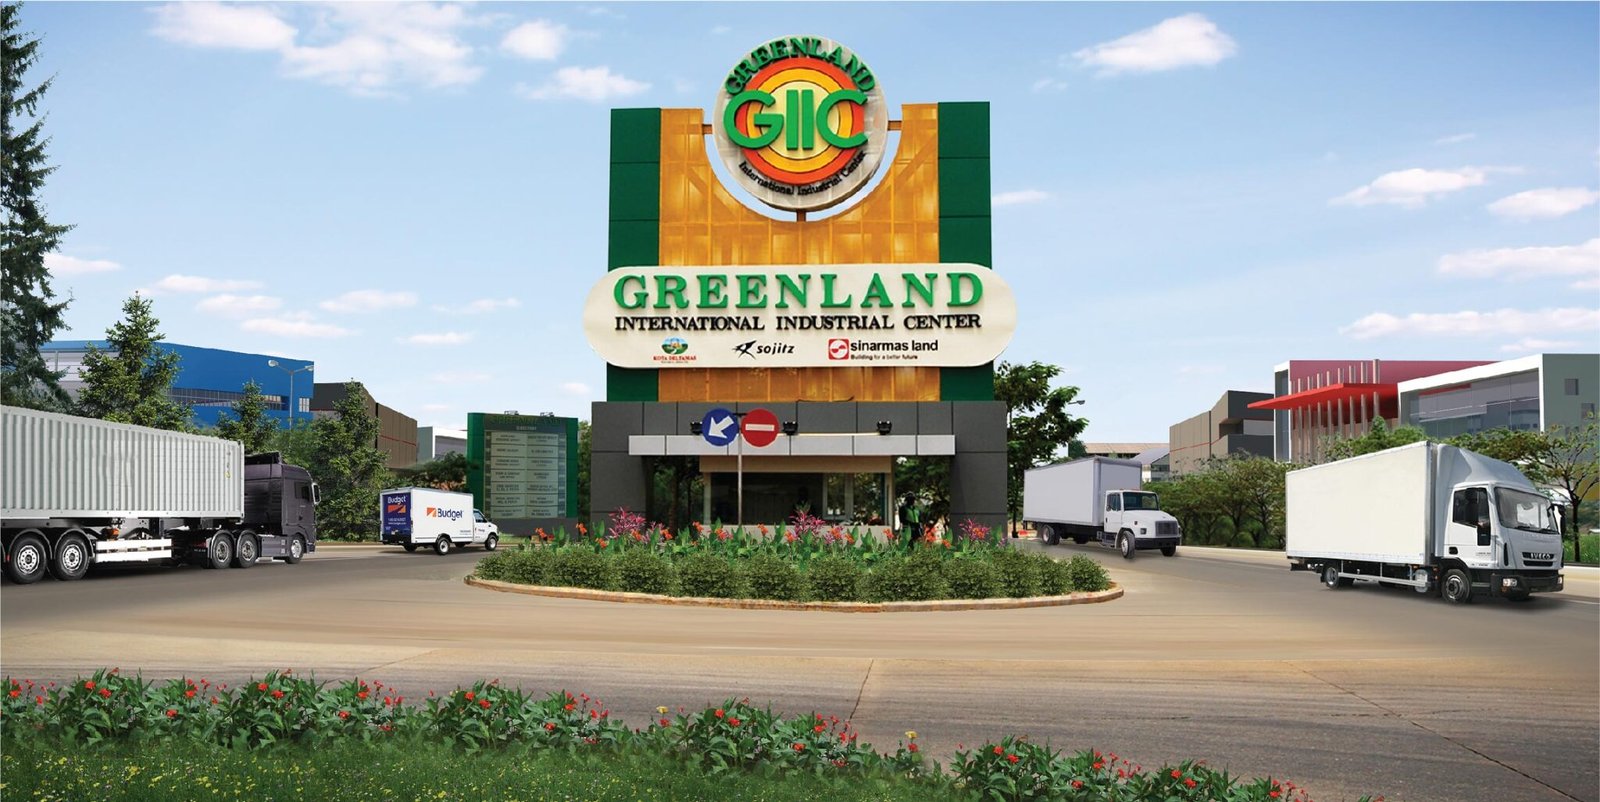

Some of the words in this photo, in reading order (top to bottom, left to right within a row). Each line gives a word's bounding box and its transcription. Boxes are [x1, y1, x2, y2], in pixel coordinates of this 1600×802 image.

[725, 36, 876, 95] GREENLAND
[723, 88, 869, 150] GIIC
[738, 160, 795, 196] International
[797, 173, 842, 196] Industrial
[841, 151, 866, 178] Center
[613, 272, 984, 310] GREENLAND
[614, 316, 765, 331] INTERNATIONAL
[775, 315, 895, 330] INDUSTRIAL
[903, 313, 982, 329] CENTER
[756, 342, 795, 356] sojitz
[850, 339, 909, 351] sinarmas
[911, 339, 939, 351] land
[387, 495, 407, 505] Budget
[437, 507, 464, 521] Budget
[1530, 552, 1551, 560] IVECO
